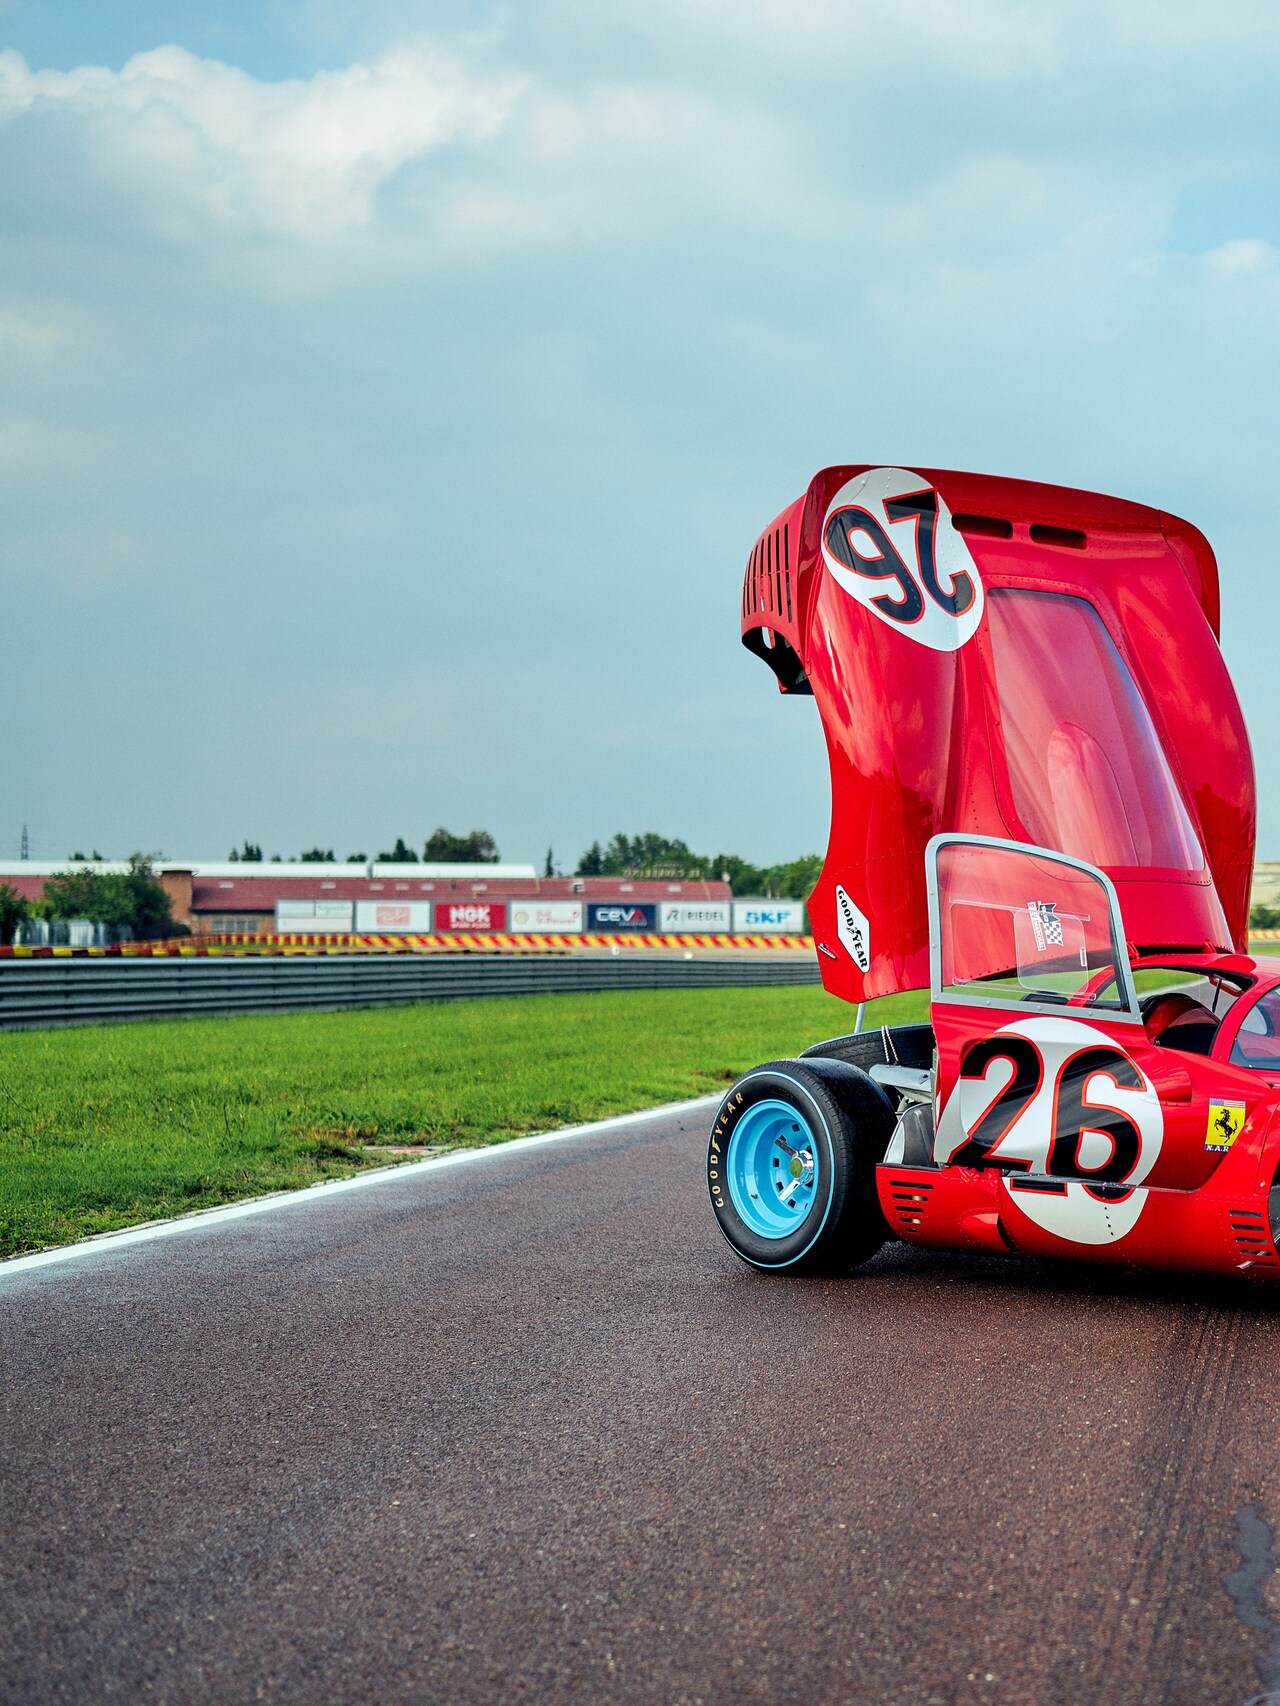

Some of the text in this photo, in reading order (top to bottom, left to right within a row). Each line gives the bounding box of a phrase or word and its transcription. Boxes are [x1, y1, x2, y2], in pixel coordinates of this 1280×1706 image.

[823, 487, 977, 625] 26
[450, 906, 491, 922] NGK
[687, 911, 725, 921] RIEDEL
[745, 911, 791, 924] SKF
[946, 1032, 1148, 1204] 26
